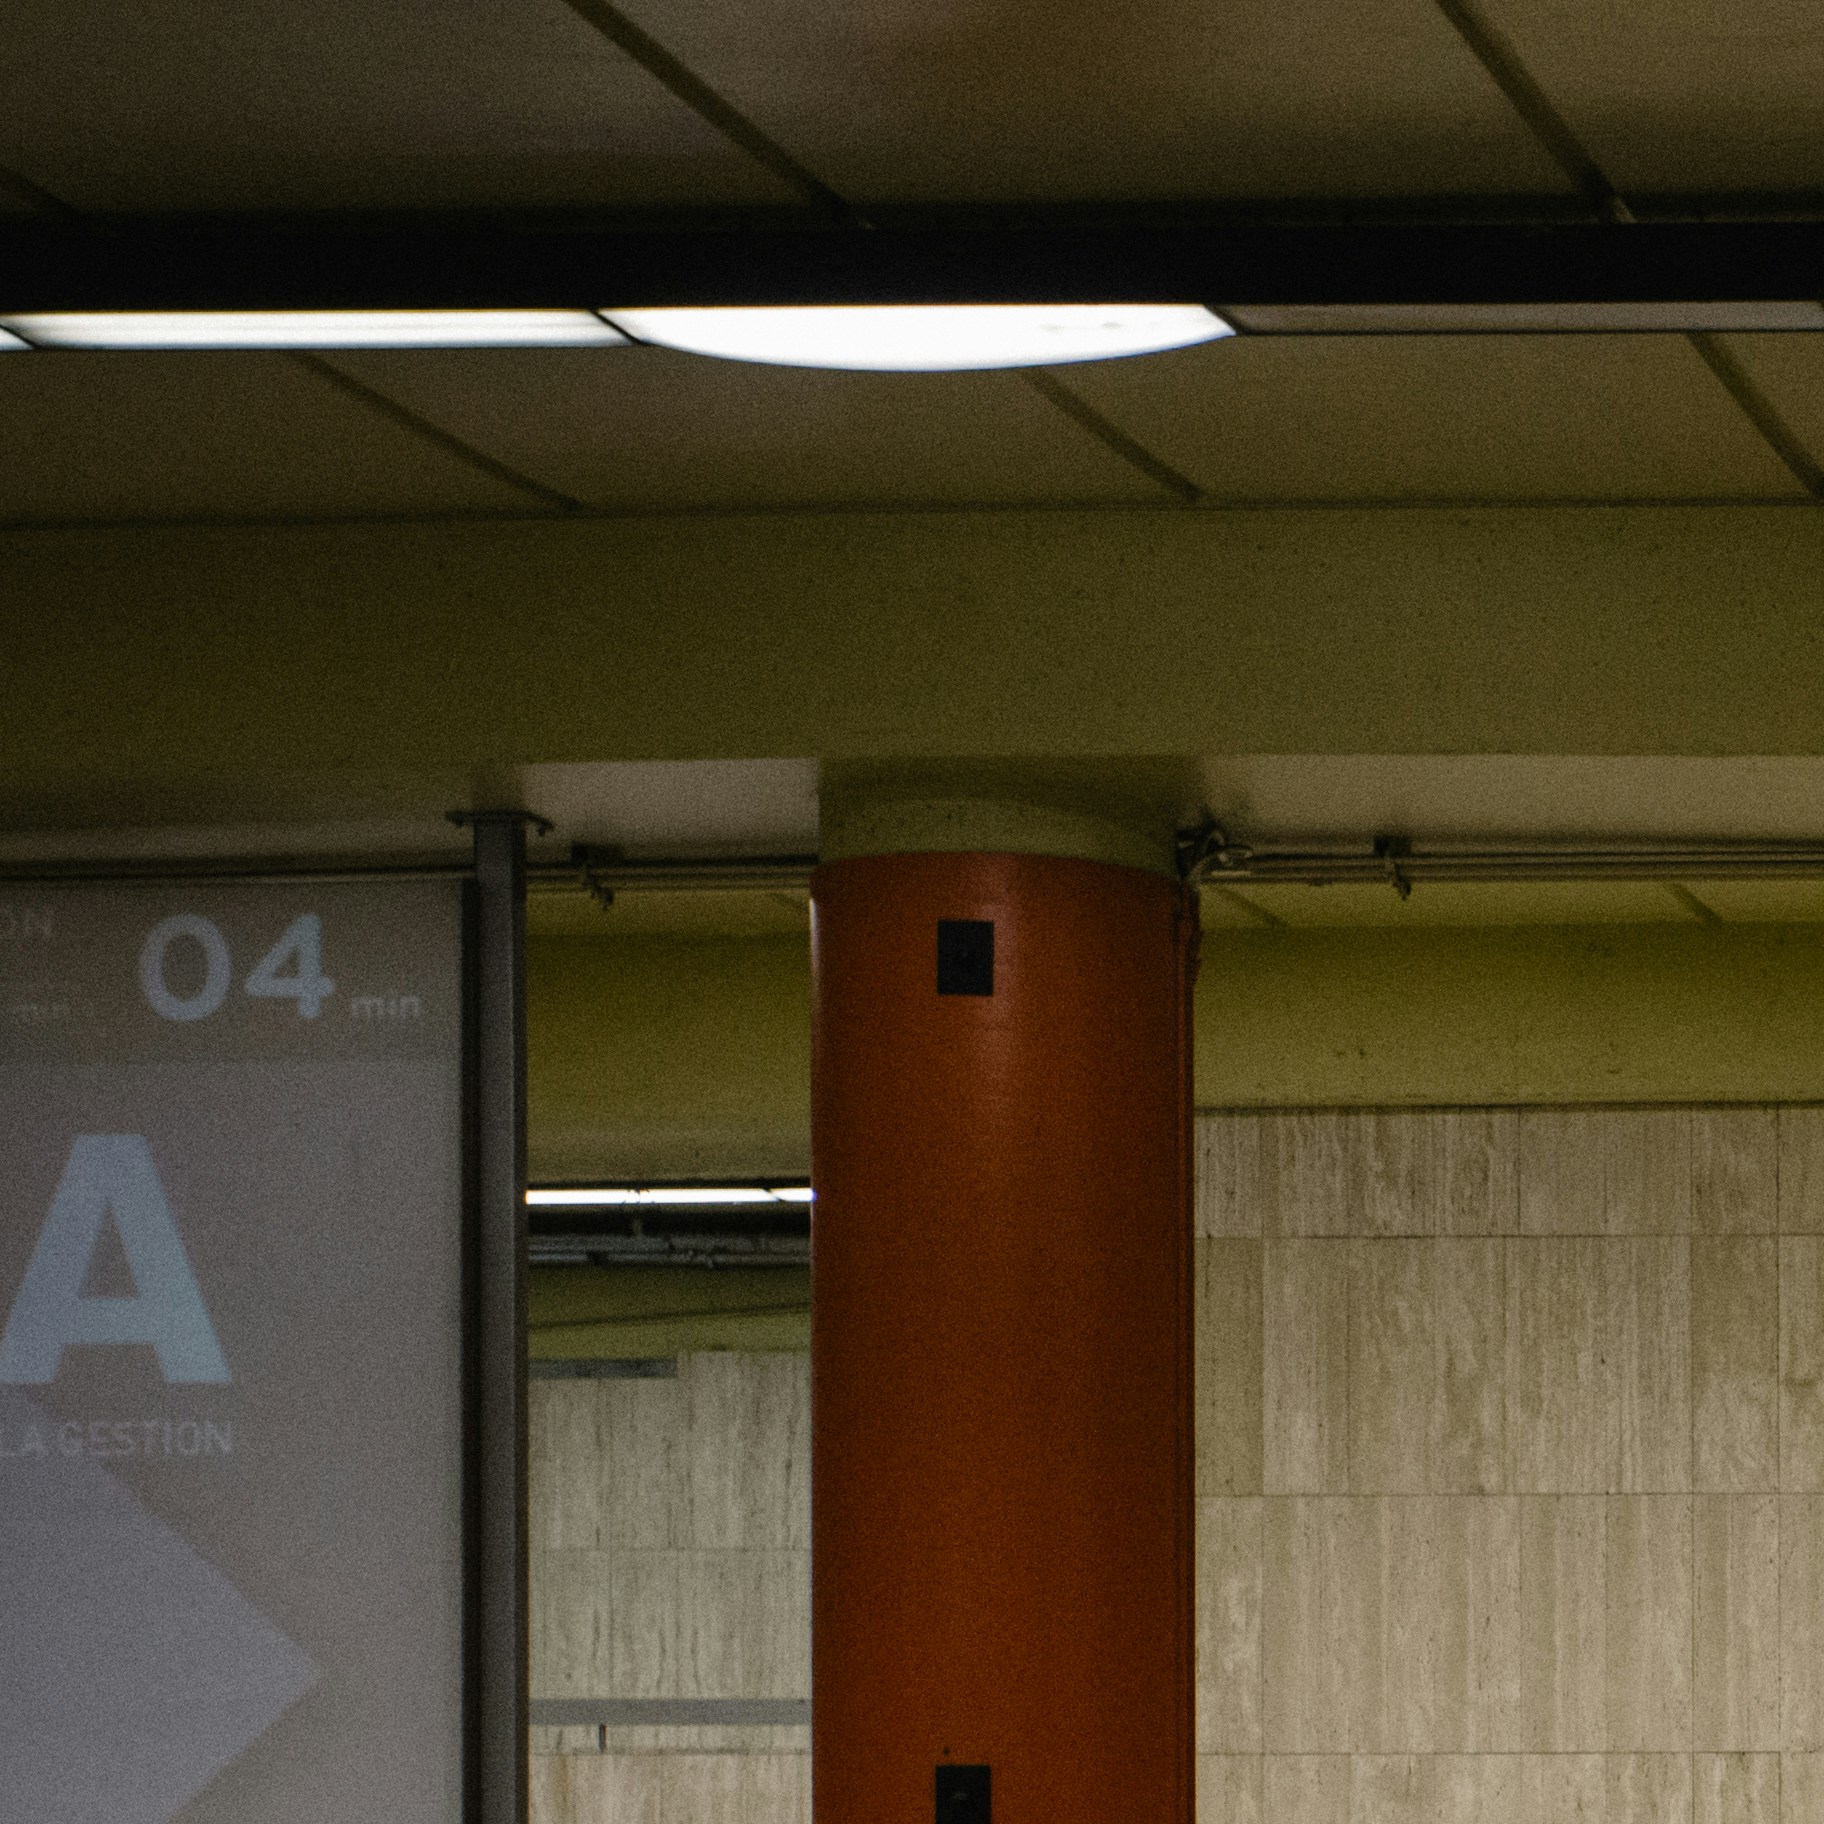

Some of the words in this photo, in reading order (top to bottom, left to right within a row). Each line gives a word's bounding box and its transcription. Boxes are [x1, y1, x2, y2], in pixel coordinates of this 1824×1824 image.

[138, 912, 336, 1022] 04
[349, 986, 423, 1019] min
[0, 1134, 233, 1384] A
[57, 1418, 234, 1457] GESTION
